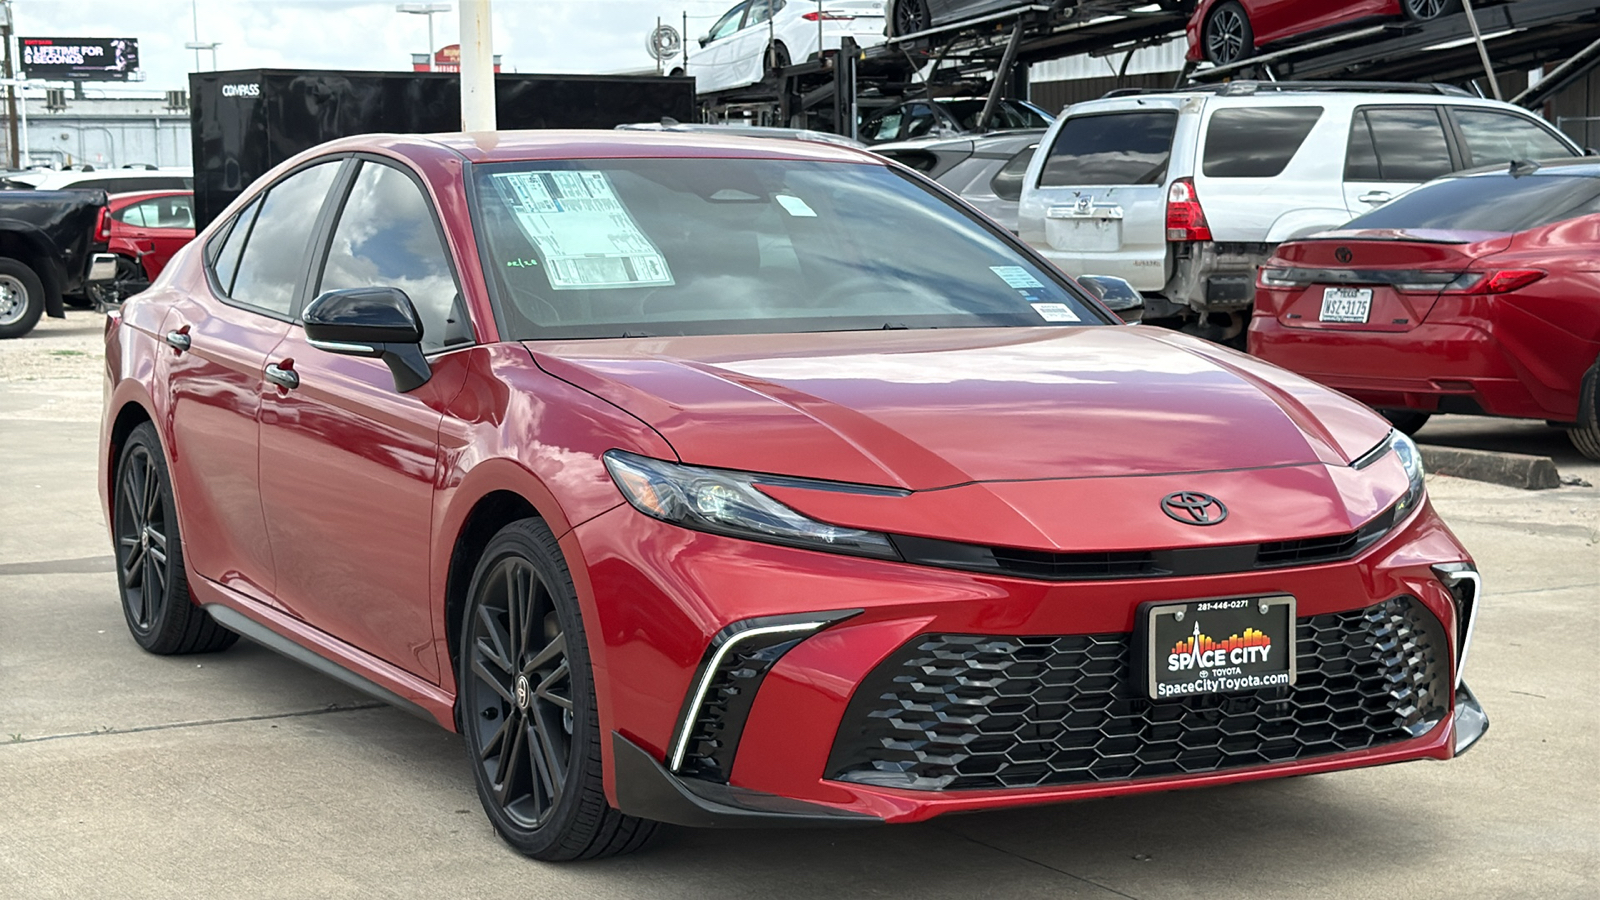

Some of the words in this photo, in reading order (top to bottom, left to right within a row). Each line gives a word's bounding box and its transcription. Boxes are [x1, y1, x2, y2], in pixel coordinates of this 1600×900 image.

[24, 46, 33, 55] A
[33, 46, 80, 56] LIFETIME
[81, 46, 104, 56] FOR
[33, 54, 84, 64] SECONDS
[222, 83, 260, 96] COMPASS
[1340, 290, 1358, 298] TEXAS
[1168, 649, 1226, 671] SPACE
[1230, 645, 1271, 664] CITY
[1212, 667, 1242, 677] TOYOTA
[1158, 673, 1288, 696] SpaceCityToyota.com
